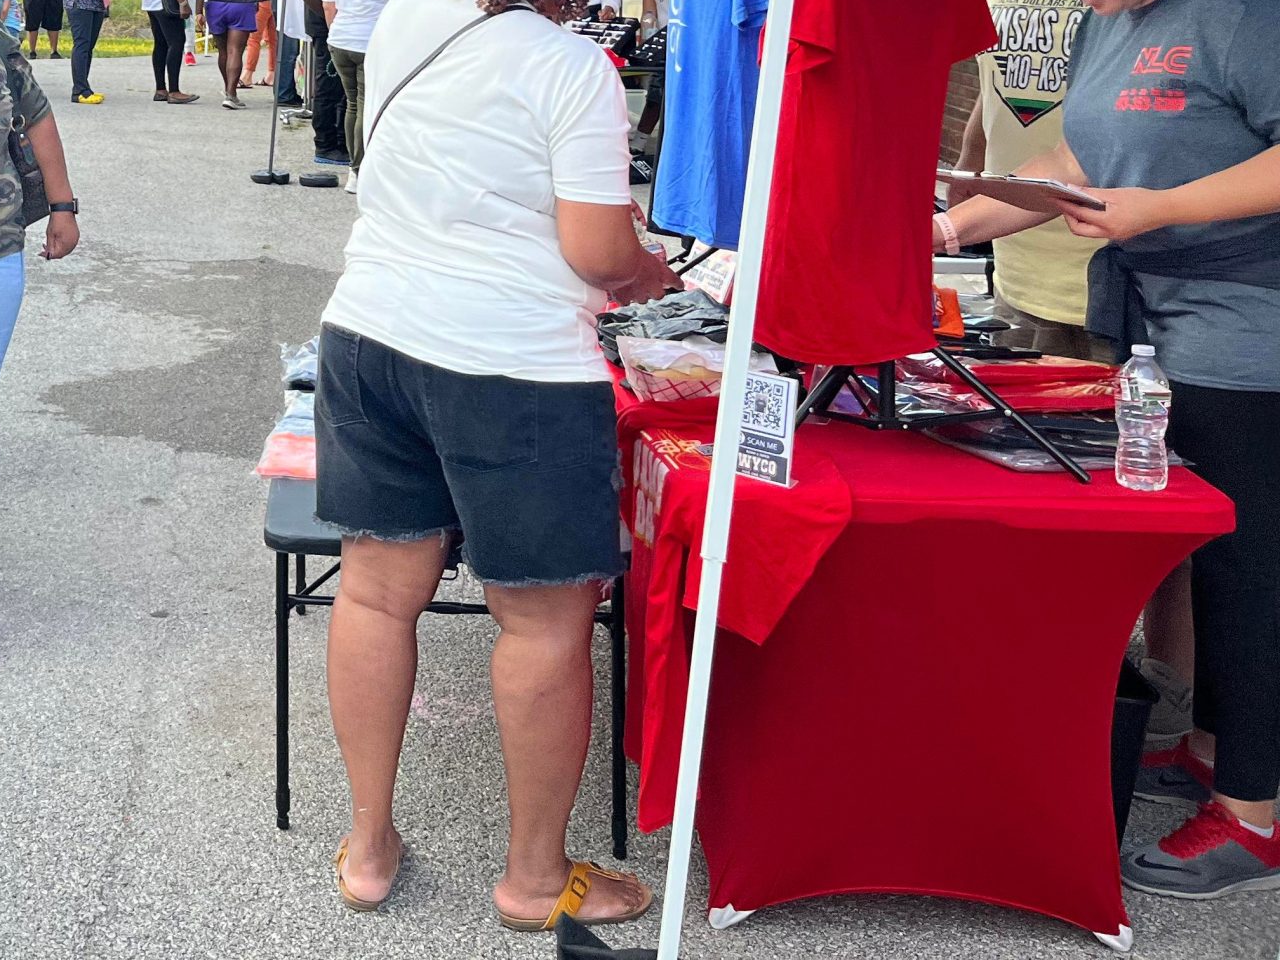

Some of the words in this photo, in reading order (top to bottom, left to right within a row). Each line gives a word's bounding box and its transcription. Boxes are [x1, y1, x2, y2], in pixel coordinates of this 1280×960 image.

[986, 6, 1059, 54] NSAS
[1004, 54, 1065, 93] MO-KS
[1130, 45, 1193, 75] NLC
[746, 436, 766, 448] SCAN
[766, 442, 778, 451] ME
[738, 451, 778, 477] WYCO
